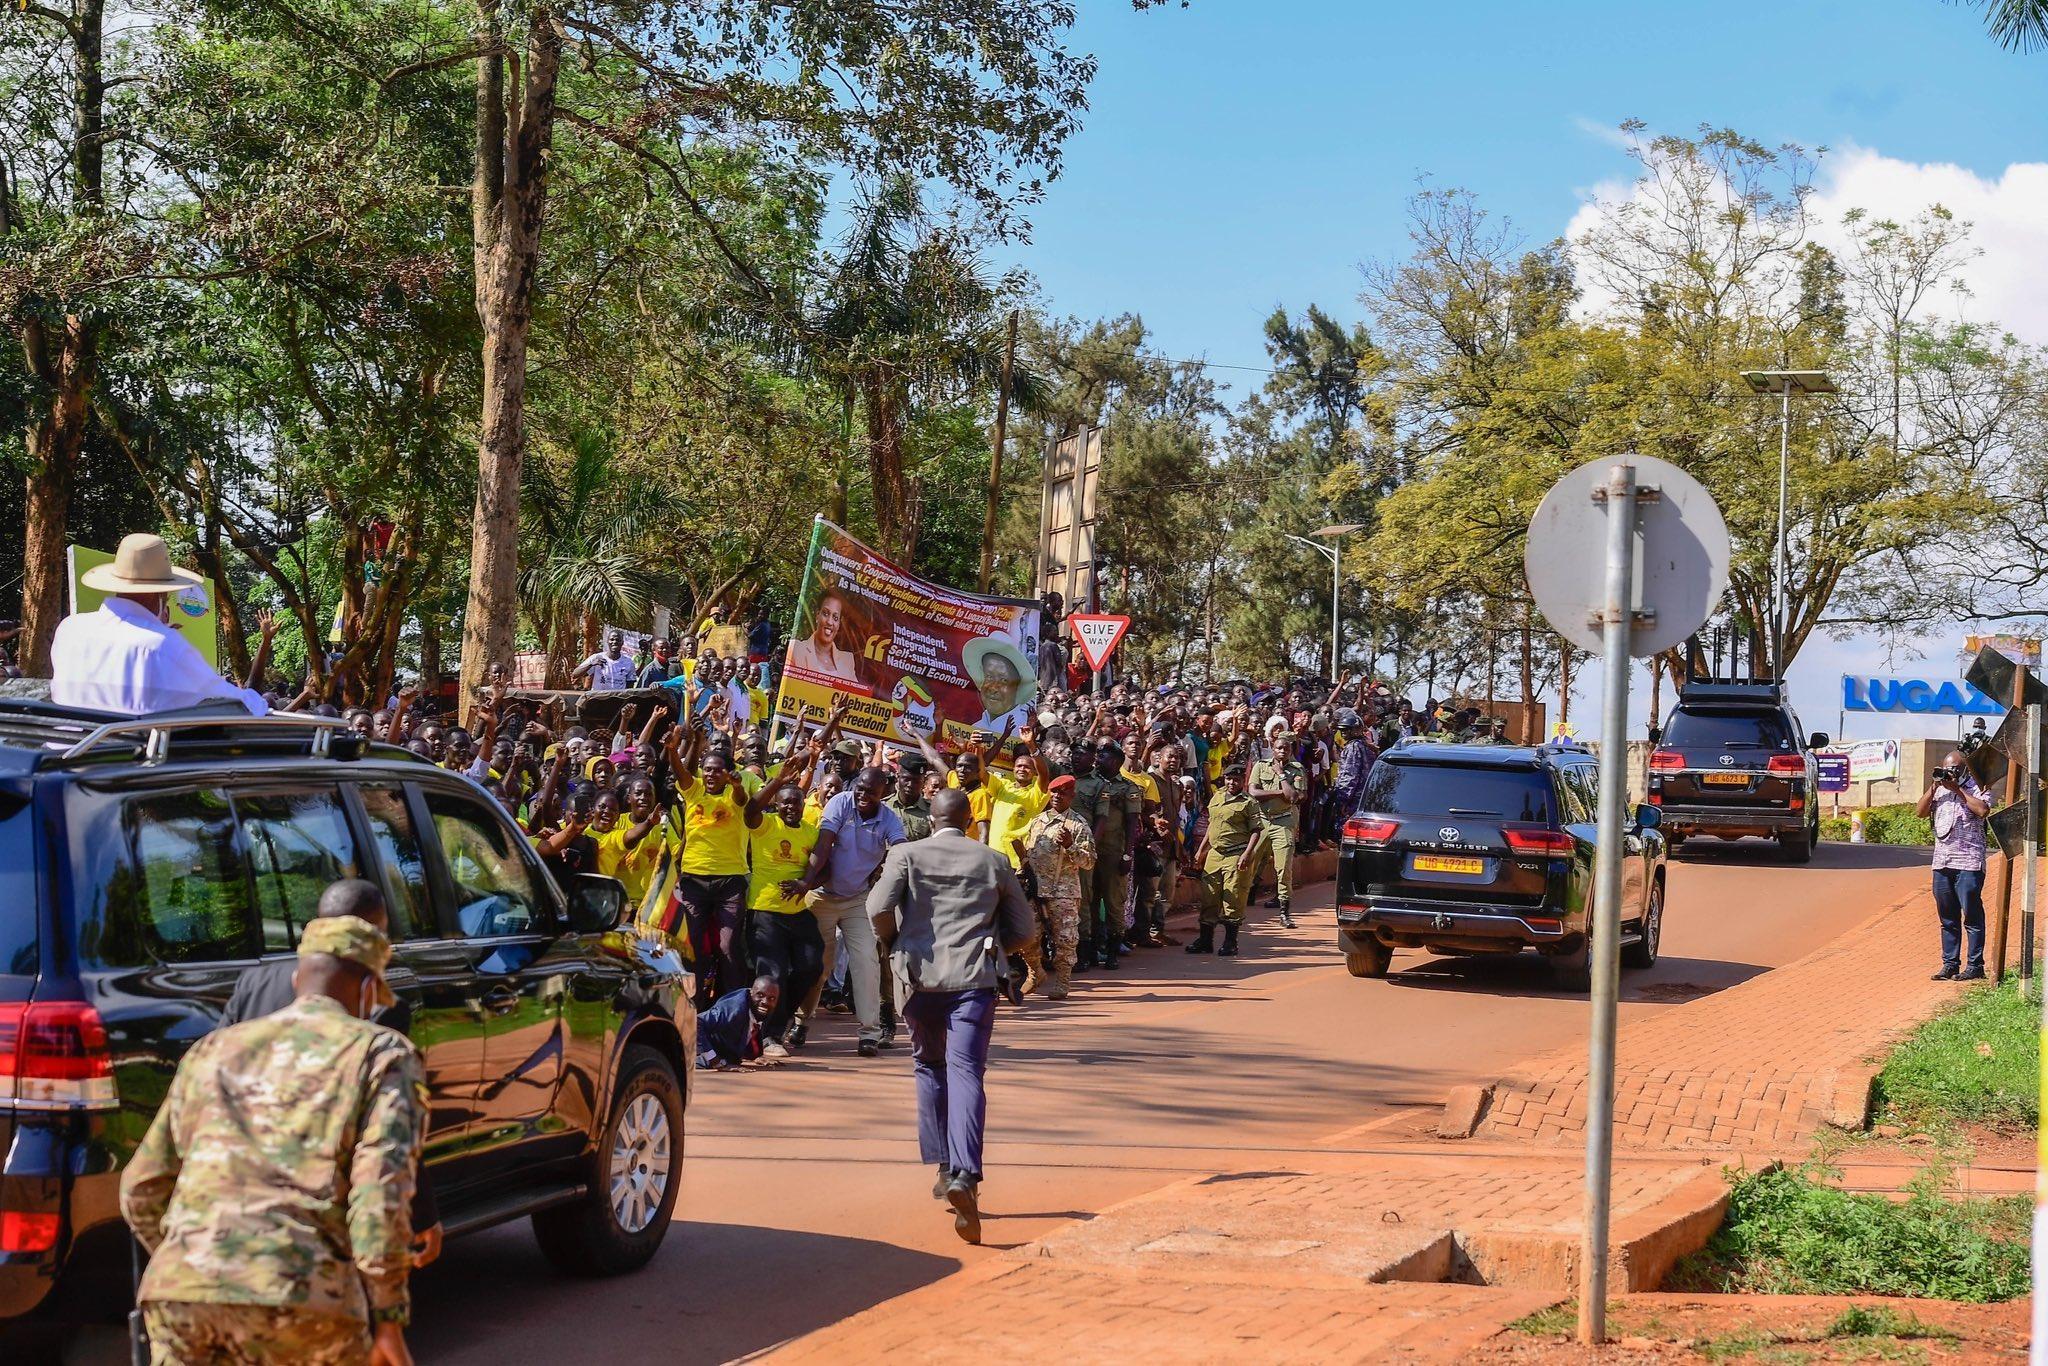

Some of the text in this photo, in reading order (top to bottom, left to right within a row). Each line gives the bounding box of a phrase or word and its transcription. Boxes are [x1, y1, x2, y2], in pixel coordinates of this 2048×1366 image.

[863, 564, 909, 588] Cooperative
[838, 577, 849, 589] As
[849, 582, 860, 593] we
[861, 587, 890, 606] celebrate
[891, 599, 925, 618] 100years
[925, 610, 934, 620] of
[954, 619, 973, 631] since
[973, 624, 989, 636] 1924
[869, 578, 883, 591] the
[883, 584, 921, 604] President
[921, 599, 931, 607] of
[930, 601, 956, 616] Uganda
[956, 608, 963, 617] to
[893, 622, 948, 651] Independent,
[1082, 623, 1115, 635] GIVE
[893, 634, 936, 657] Integrated
[1089, 638, 1109, 646] WAY
[888, 645, 957, 675] Self-sustaining
[887, 655, 970, 689] National Economy
[781, 695, 795, 711] 62
[903, 710, 930, 726] Happy
[1409, 840, 1489, 851] LAND CRUISER
[1425, 857, 1438, 868] UG
[1471, 860, 1478, 871] C
